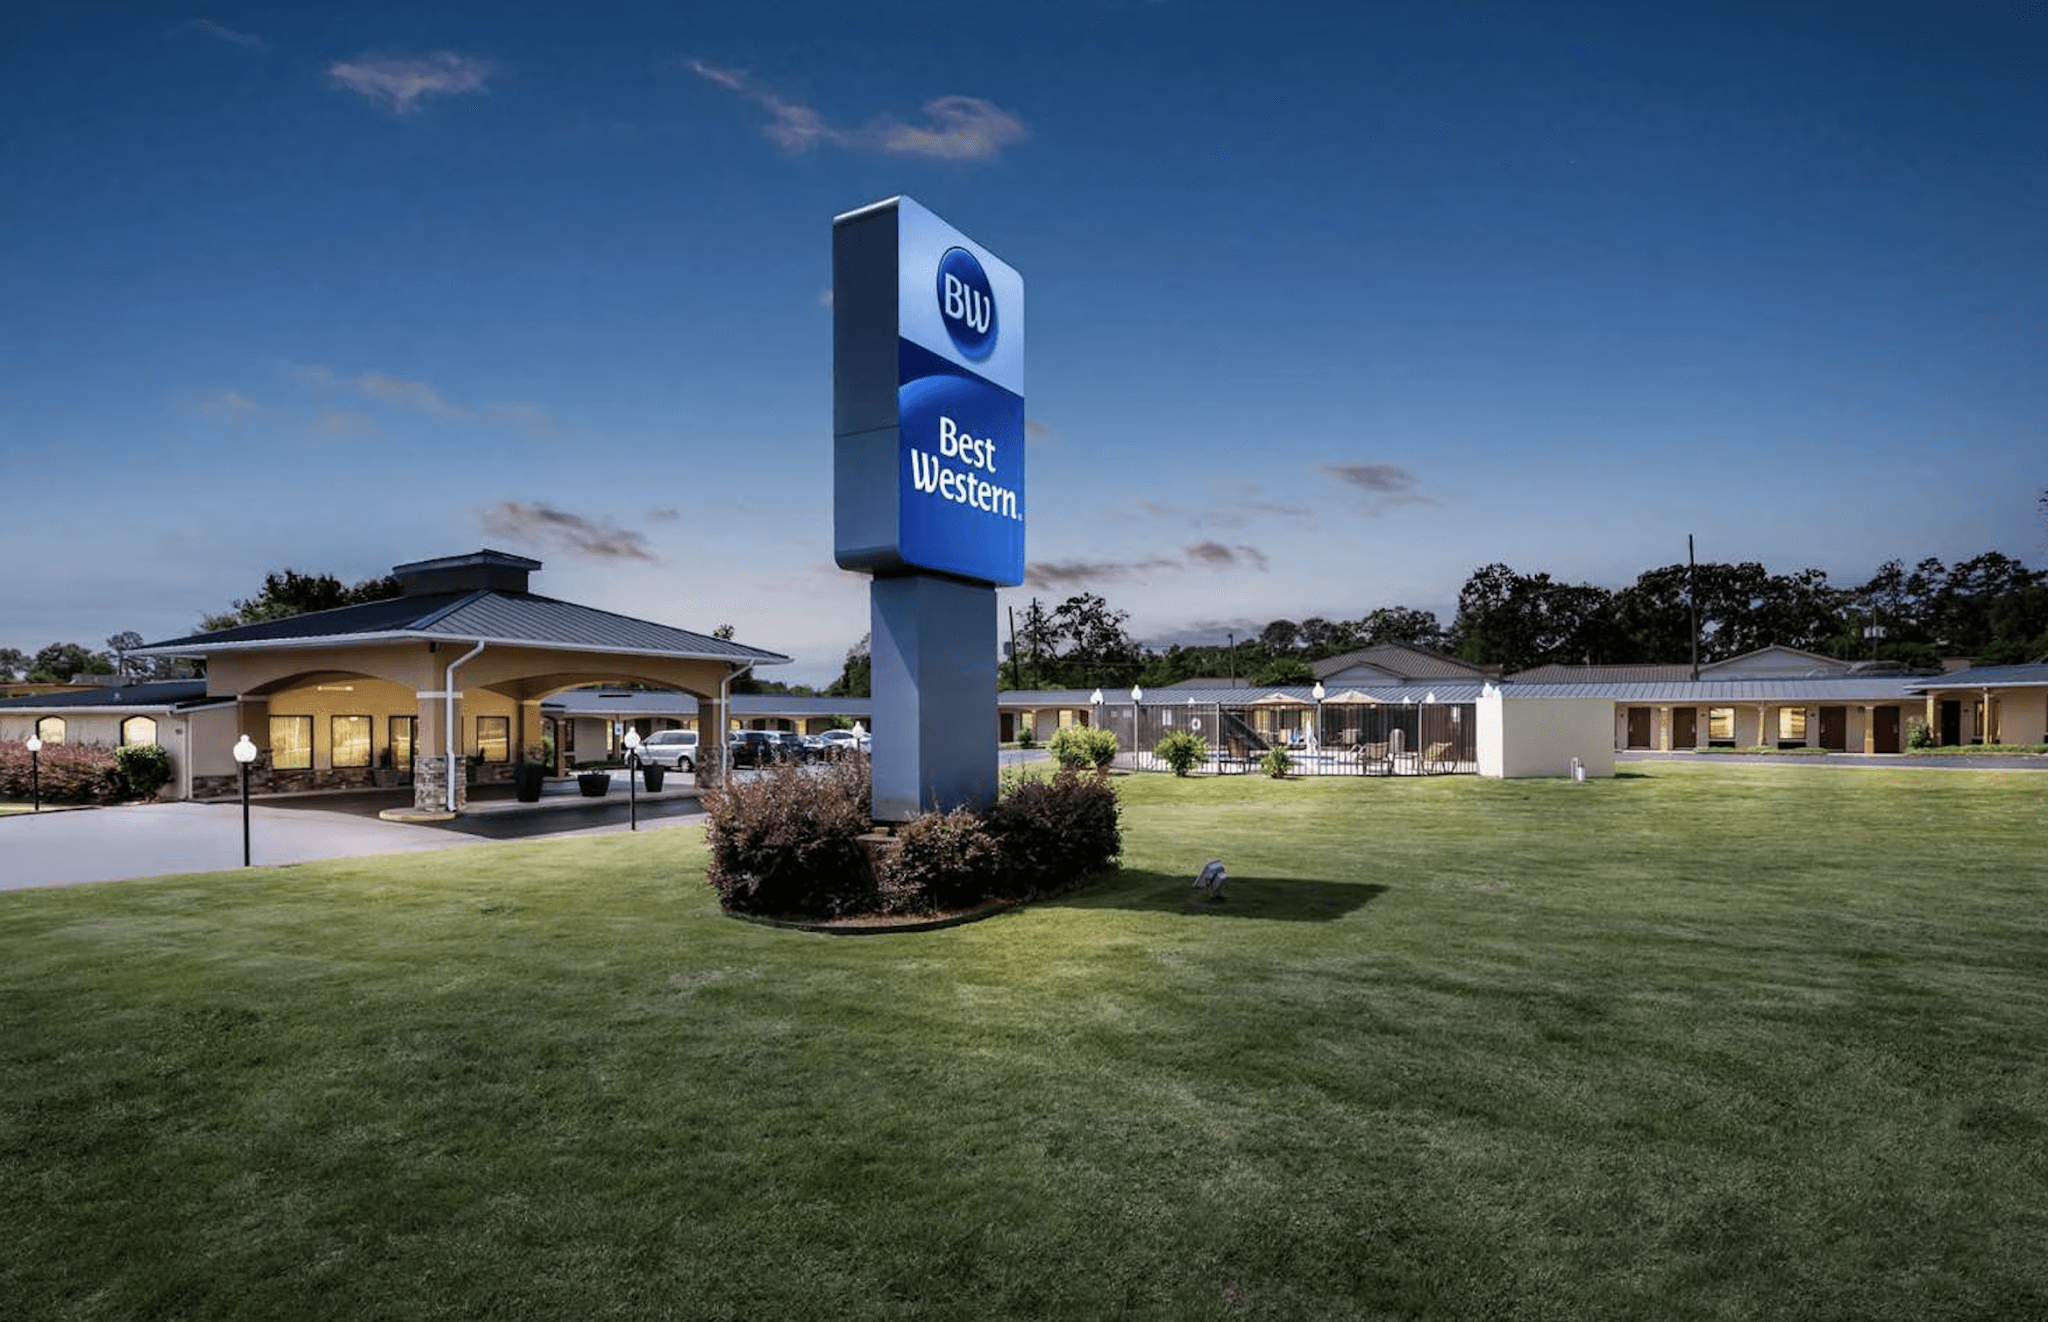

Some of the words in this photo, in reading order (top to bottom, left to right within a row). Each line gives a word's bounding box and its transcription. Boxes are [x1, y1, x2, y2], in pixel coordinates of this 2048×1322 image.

[945, 272, 990, 334] BW
[939, 416, 996, 473] Best
[911, 448, 1018, 520] Western
